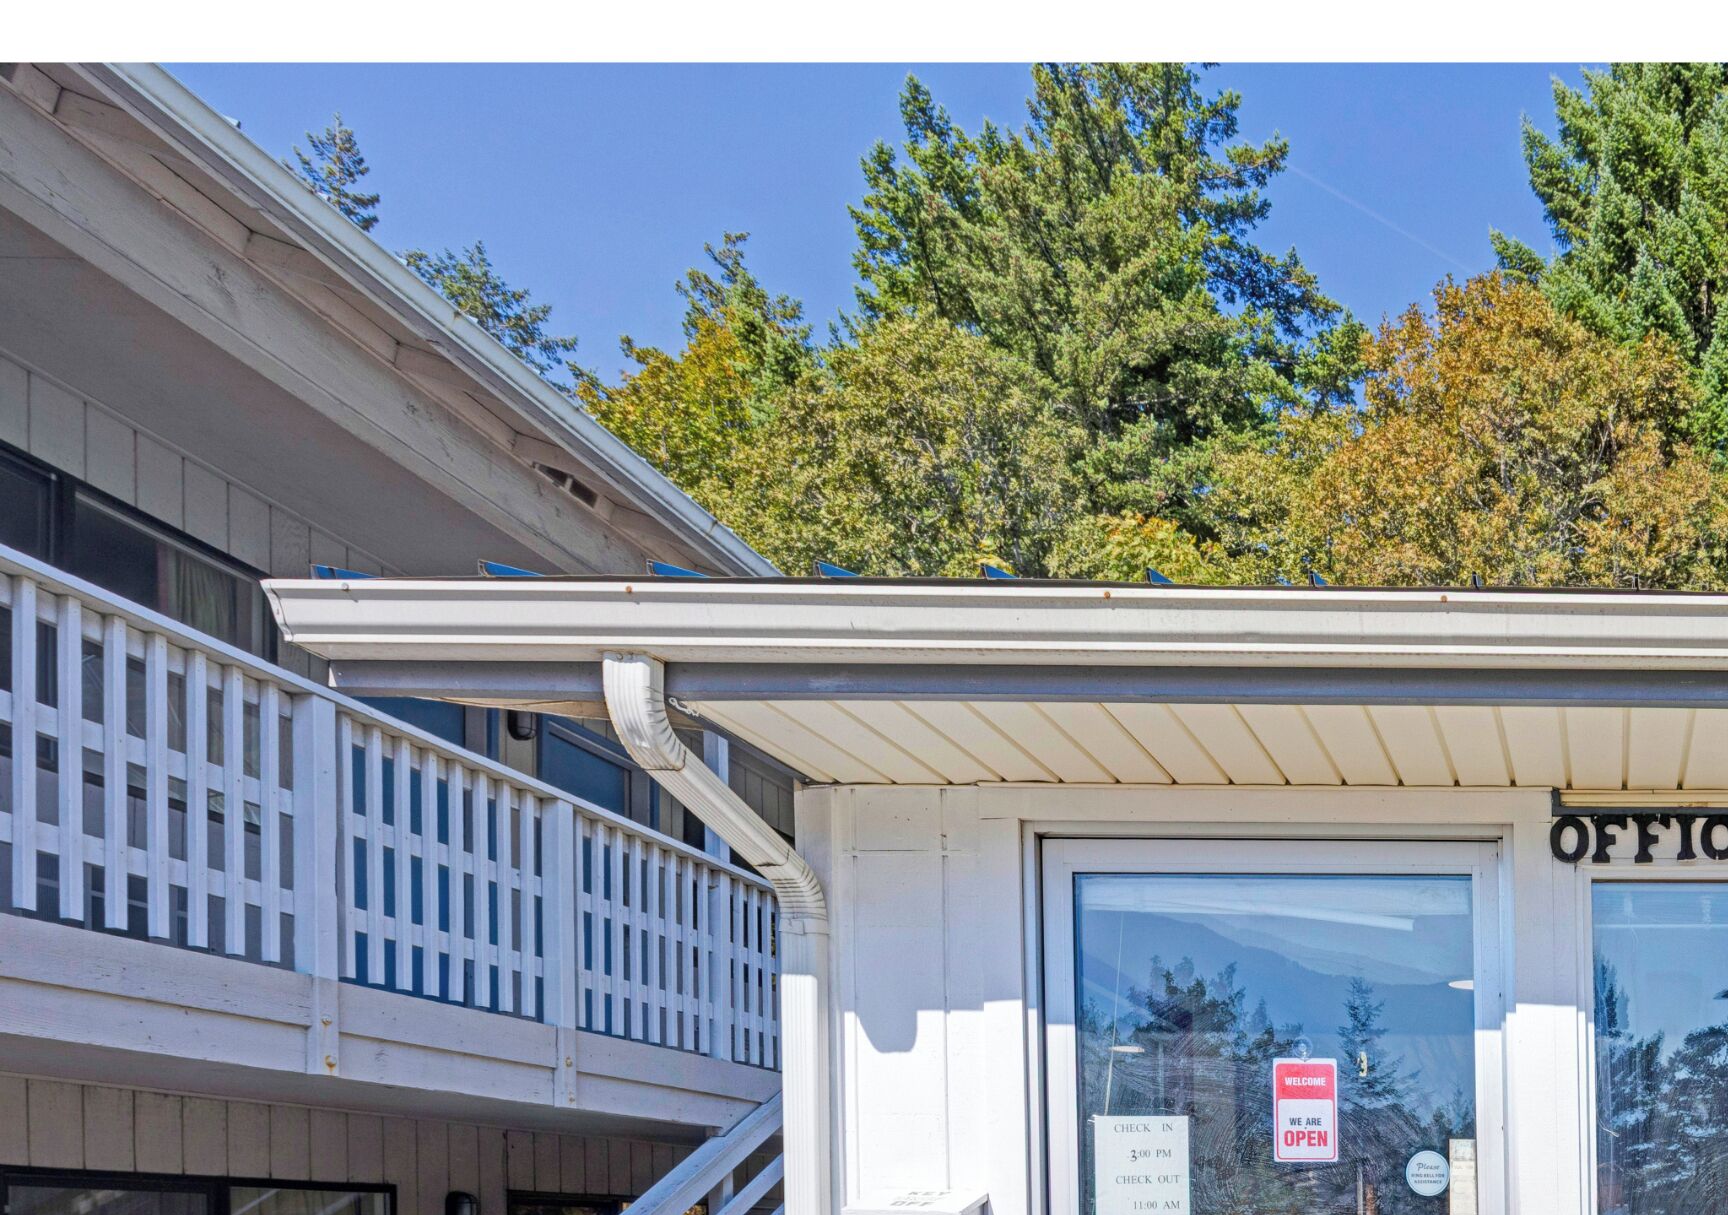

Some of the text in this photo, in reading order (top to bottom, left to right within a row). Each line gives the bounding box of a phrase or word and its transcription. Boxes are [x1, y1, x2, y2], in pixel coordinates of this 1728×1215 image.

[1284, 1077, 1327, 1086] WELCOME
[1289, 1117, 1322, 1126] WE ARE
[1114, 1123, 1173, 1133] CHECK IN
[1284, 1130, 1328, 1147] OPEN
[1156, 1149, 1172, 1158] PM
[1416, 1162, 1440, 1171] Please
[1115, 1174, 1181, 1185] CHECK OUT
[1133, 1201, 1180, 1210] 11:00 AM
